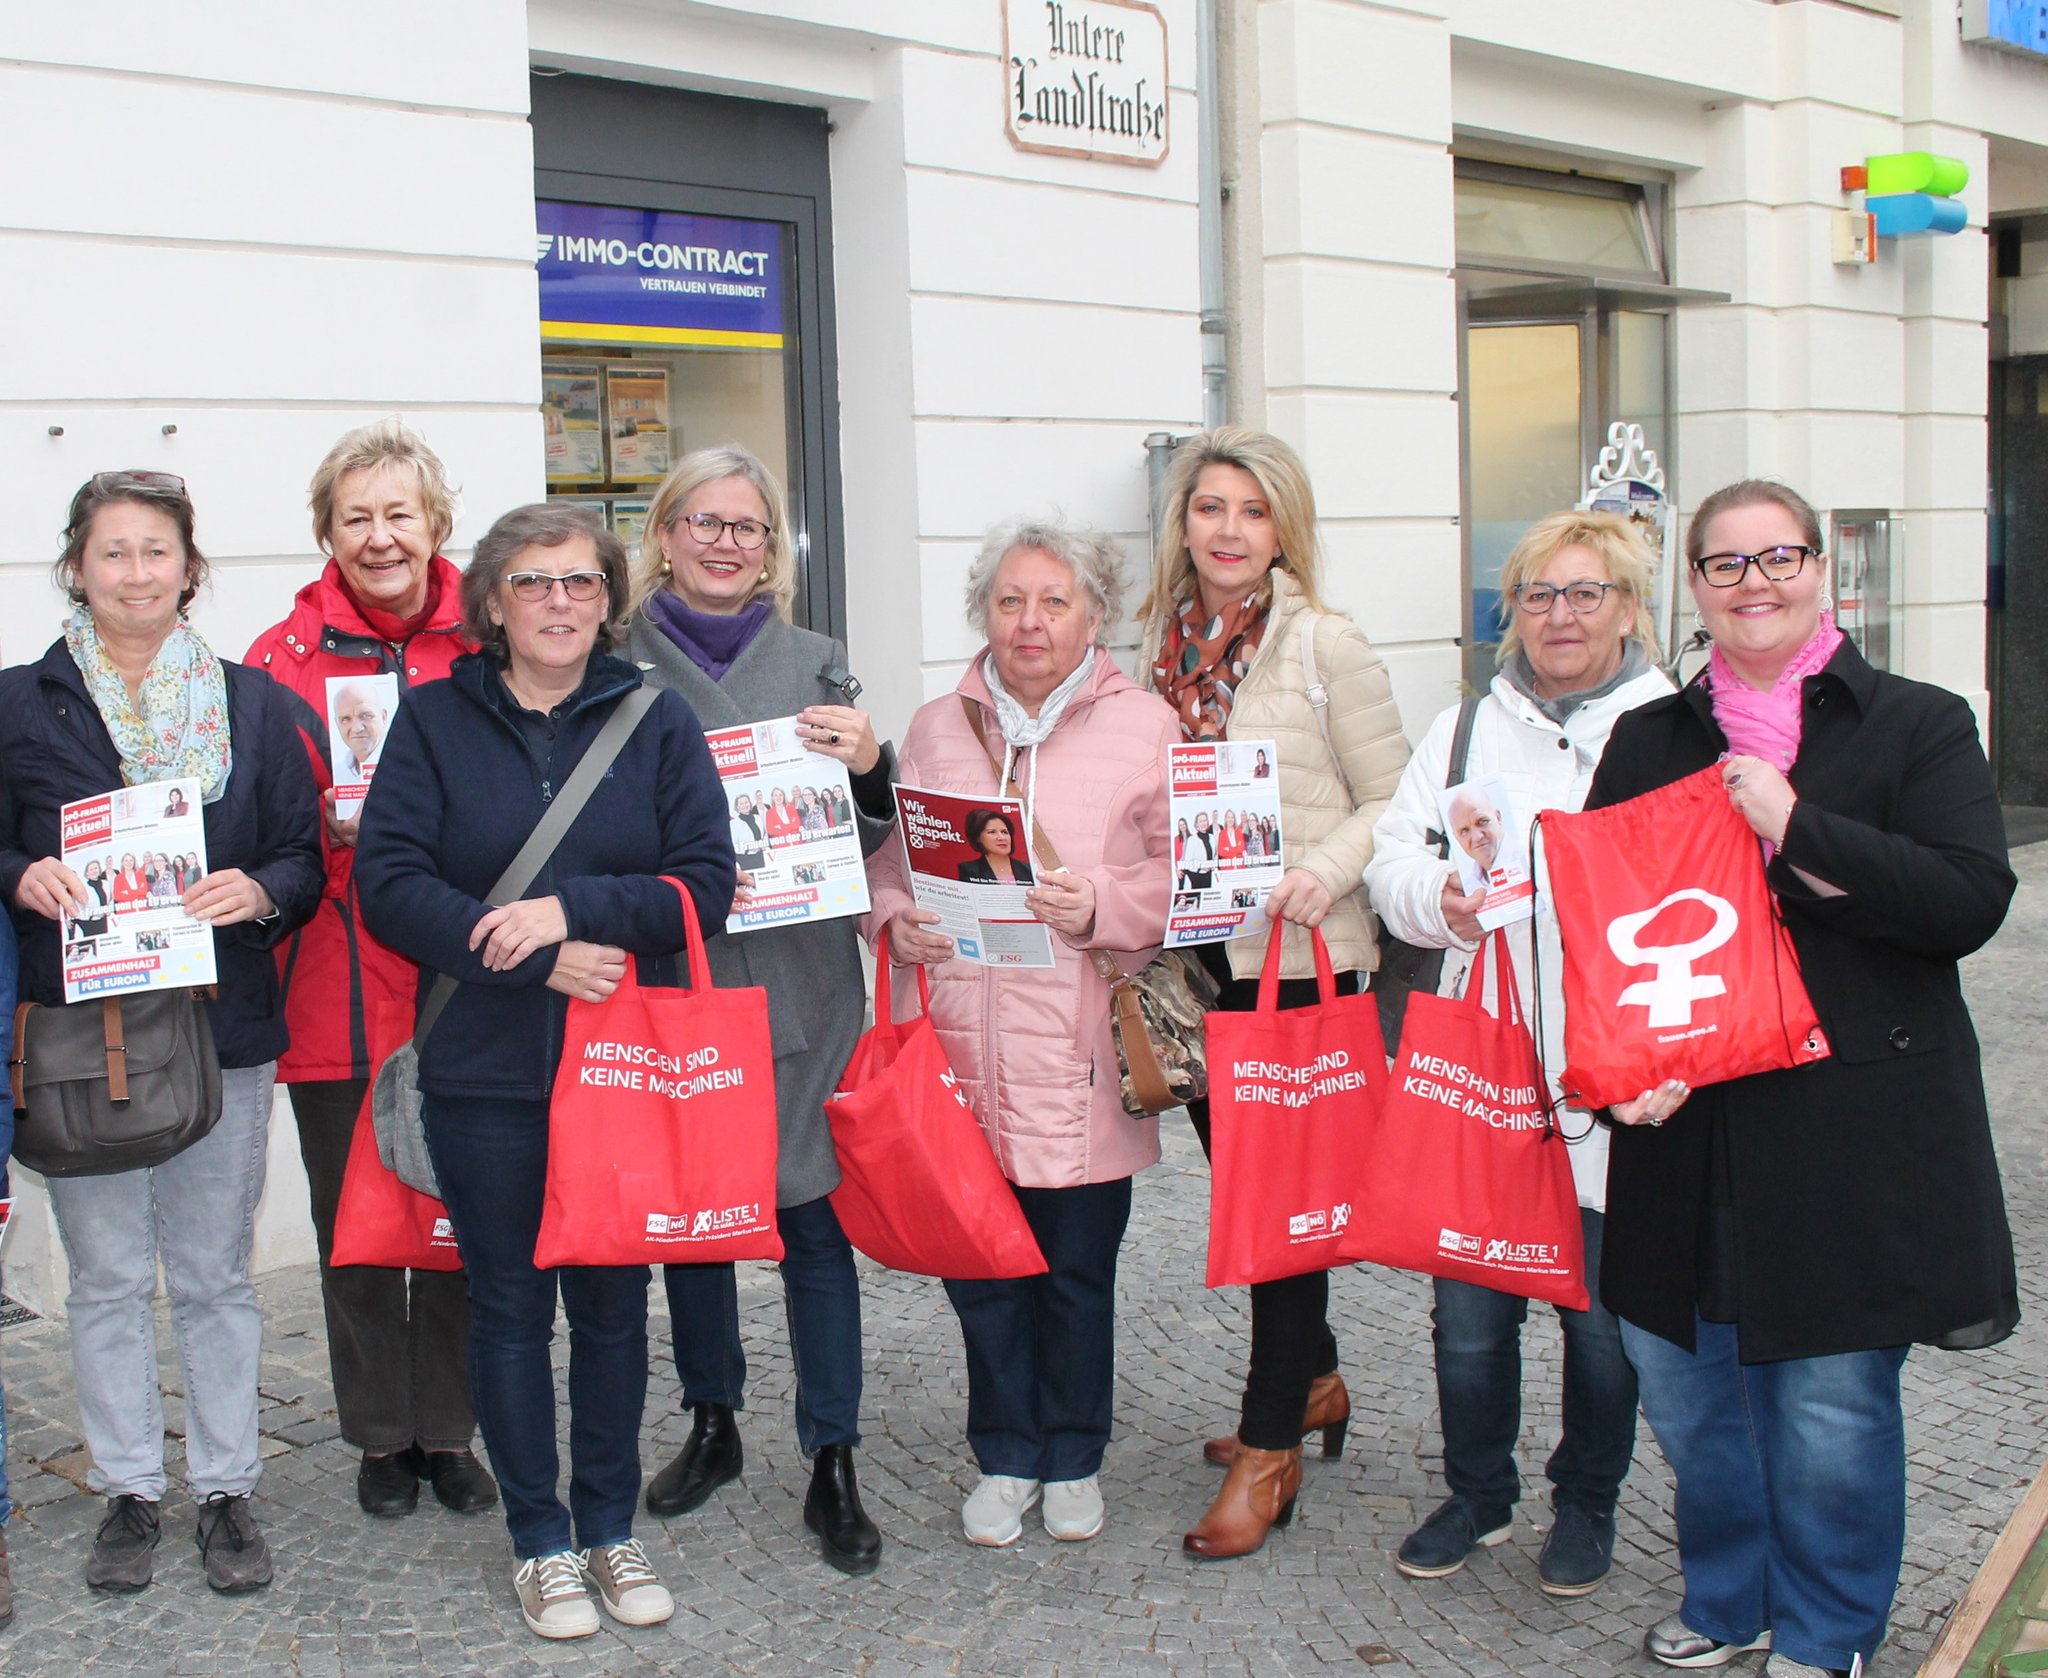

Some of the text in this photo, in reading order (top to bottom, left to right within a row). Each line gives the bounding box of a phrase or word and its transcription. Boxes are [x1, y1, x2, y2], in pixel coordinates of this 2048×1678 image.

[1046, 0, 1125, 63] Untere
[558, 235, 769, 276] IMMO-CONTRACT
[640, 277, 767, 298] VERTRAUEN VERBINDET
[714, 748, 755, 767] ktuell
[1172, 753, 1216, 764] SPÖ-FRAUEN
[1174, 766, 1216, 781] Aktuell
[64, 803, 110, 823] SPÖ-FRAUEN
[902, 798, 926, 814] Wir
[65, 815, 110, 838] Aktuell
[905, 813, 952, 830] wählen
[769, 836, 785, 845] von
[786, 833, 801, 843] der
[801, 831, 812, 840] EU
[812, 825, 851, 839] erwarten
[908, 822, 965, 844] Respekt.
[115, 901, 131, 911] von
[132, 898, 147, 909] der
[148, 896, 159, 907] EU
[744, 906, 807, 924] FÜR EUROPA
[1173, 915, 1242, 929] ZUSAMMENHALT
[1180, 927, 1230, 940] FÜR EUROPA
[70, 958, 156, 980] ZUSAMMENHALT
[81, 973, 147, 991] FÜR EUROPA
[580, 1066, 643, 1090] KEINE
[1235, 1084, 1280, 1104] KEINE
[1403, 1075, 1463, 1108] KEINE
[1502, 1086, 1537, 1106] SIND
[648, 1203, 759, 1229] FSG NÖ LISTE 1
[1290, 1214, 1324, 1230] FSG NÖ
[435, 1224, 448, 1232] FSG
[705, 1231, 731, 1240] Präsident
[732, 1228, 752, 1237] Markus
[1441, 1235, 1559, 1258] FSG NÖ LISTE 1
[1497, 1263, 1526, 1272] Präsident
[1526, 1266, 1548, 1274] Markus
